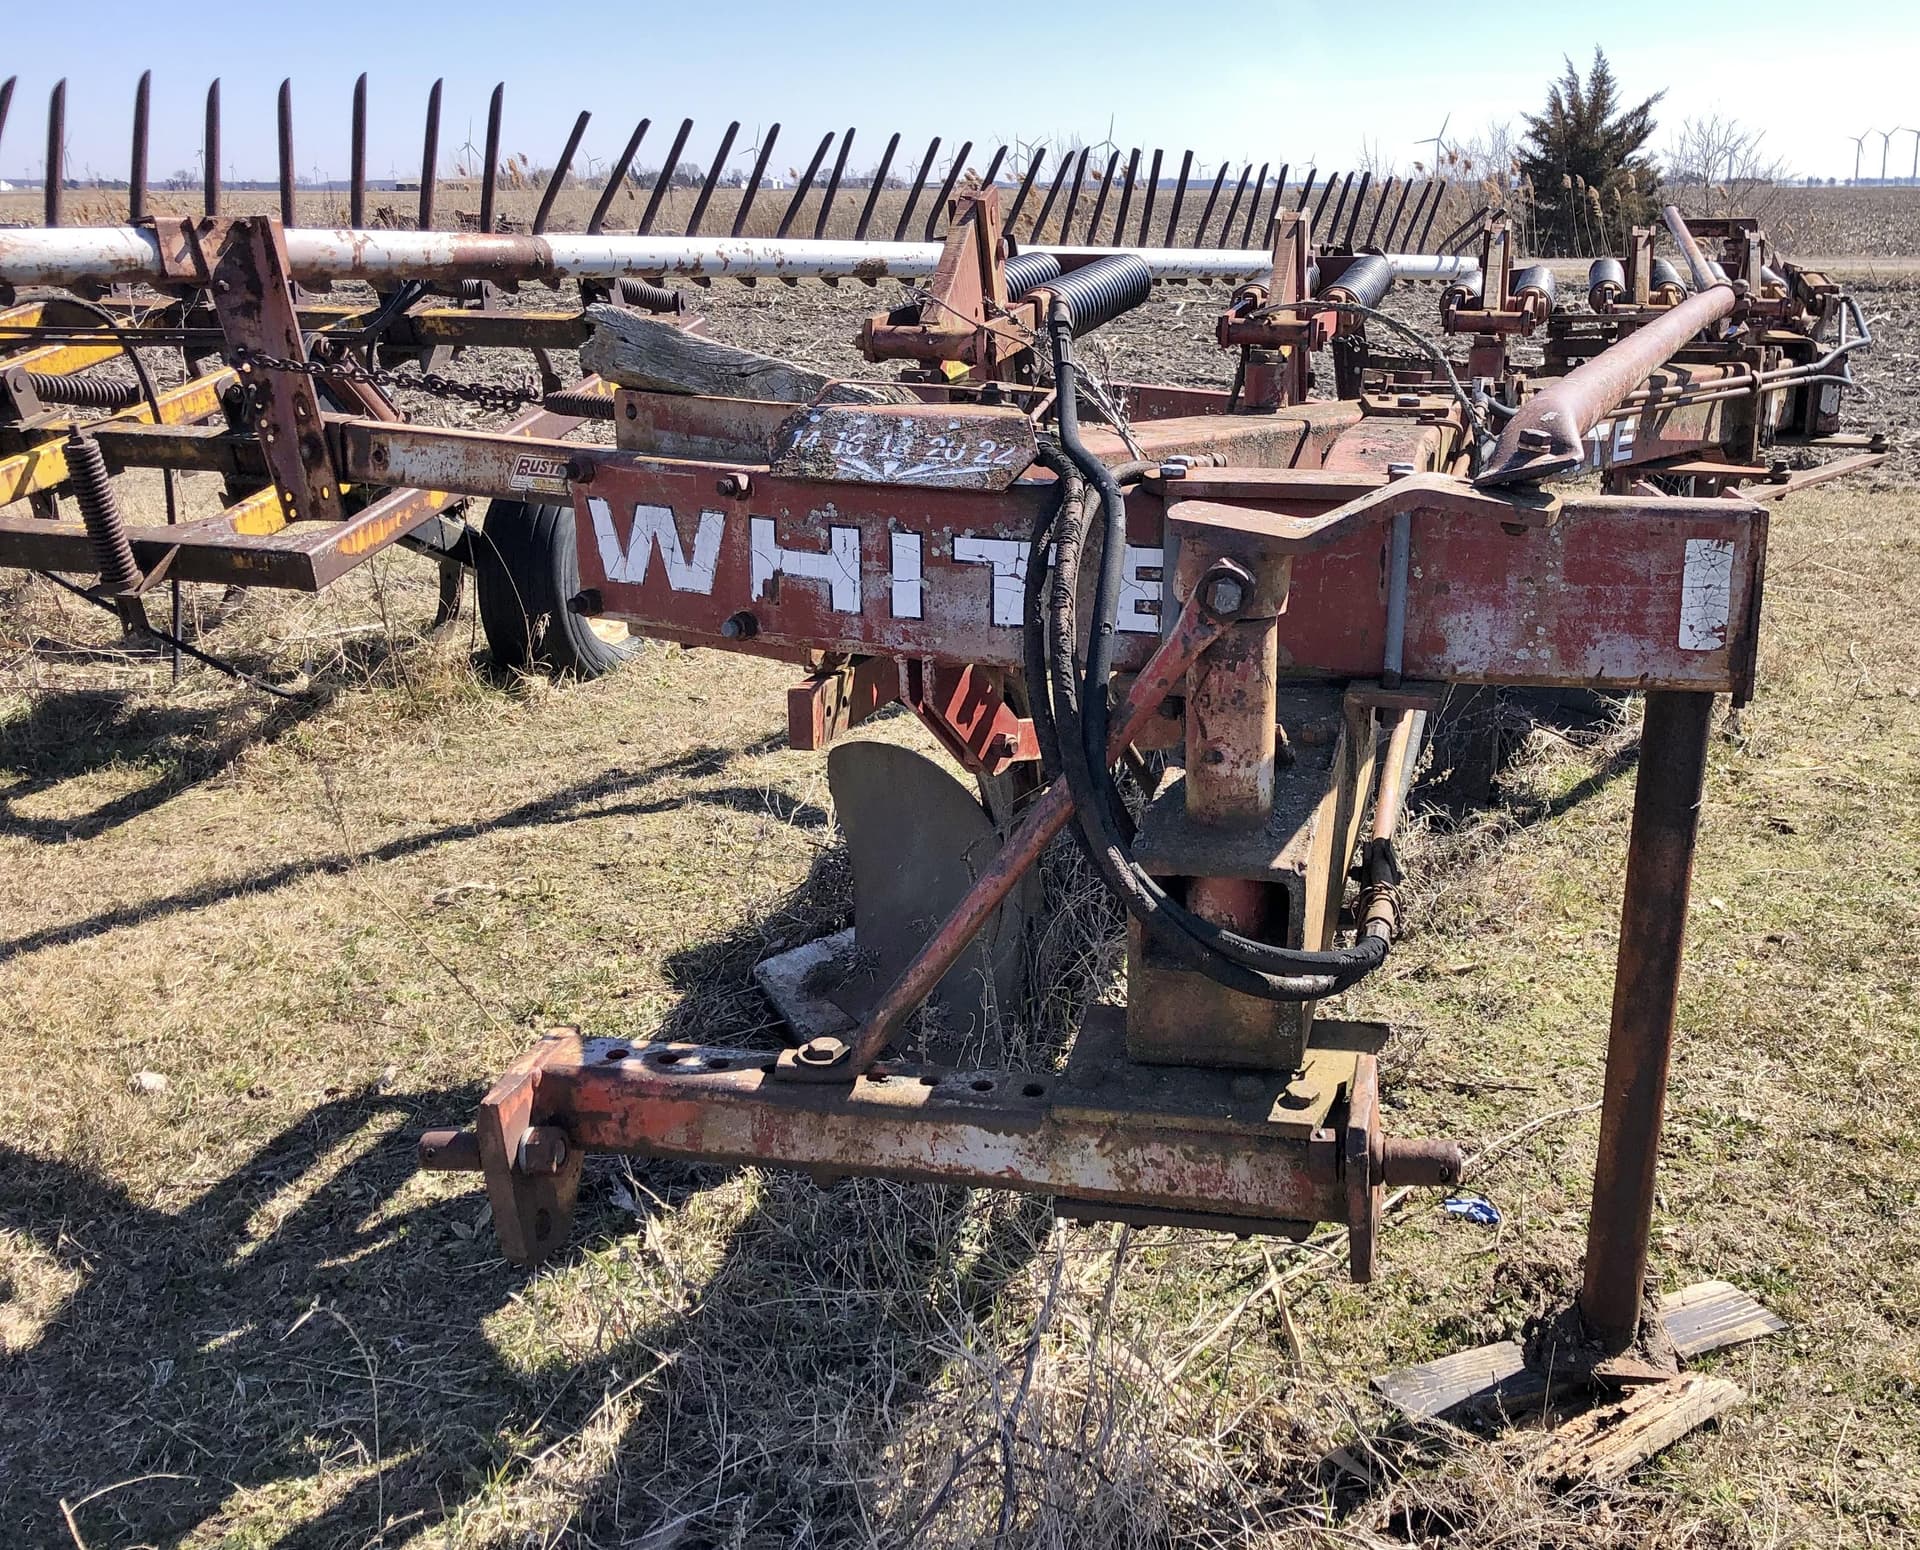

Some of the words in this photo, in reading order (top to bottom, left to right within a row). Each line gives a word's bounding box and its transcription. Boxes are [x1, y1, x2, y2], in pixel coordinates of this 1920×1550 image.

[791, 430, 820, 453] 14
[830, 431, 866, 455] 16
[973, 440, 1016, 464] 22
[586, 496, 1164, 633] WHITE
